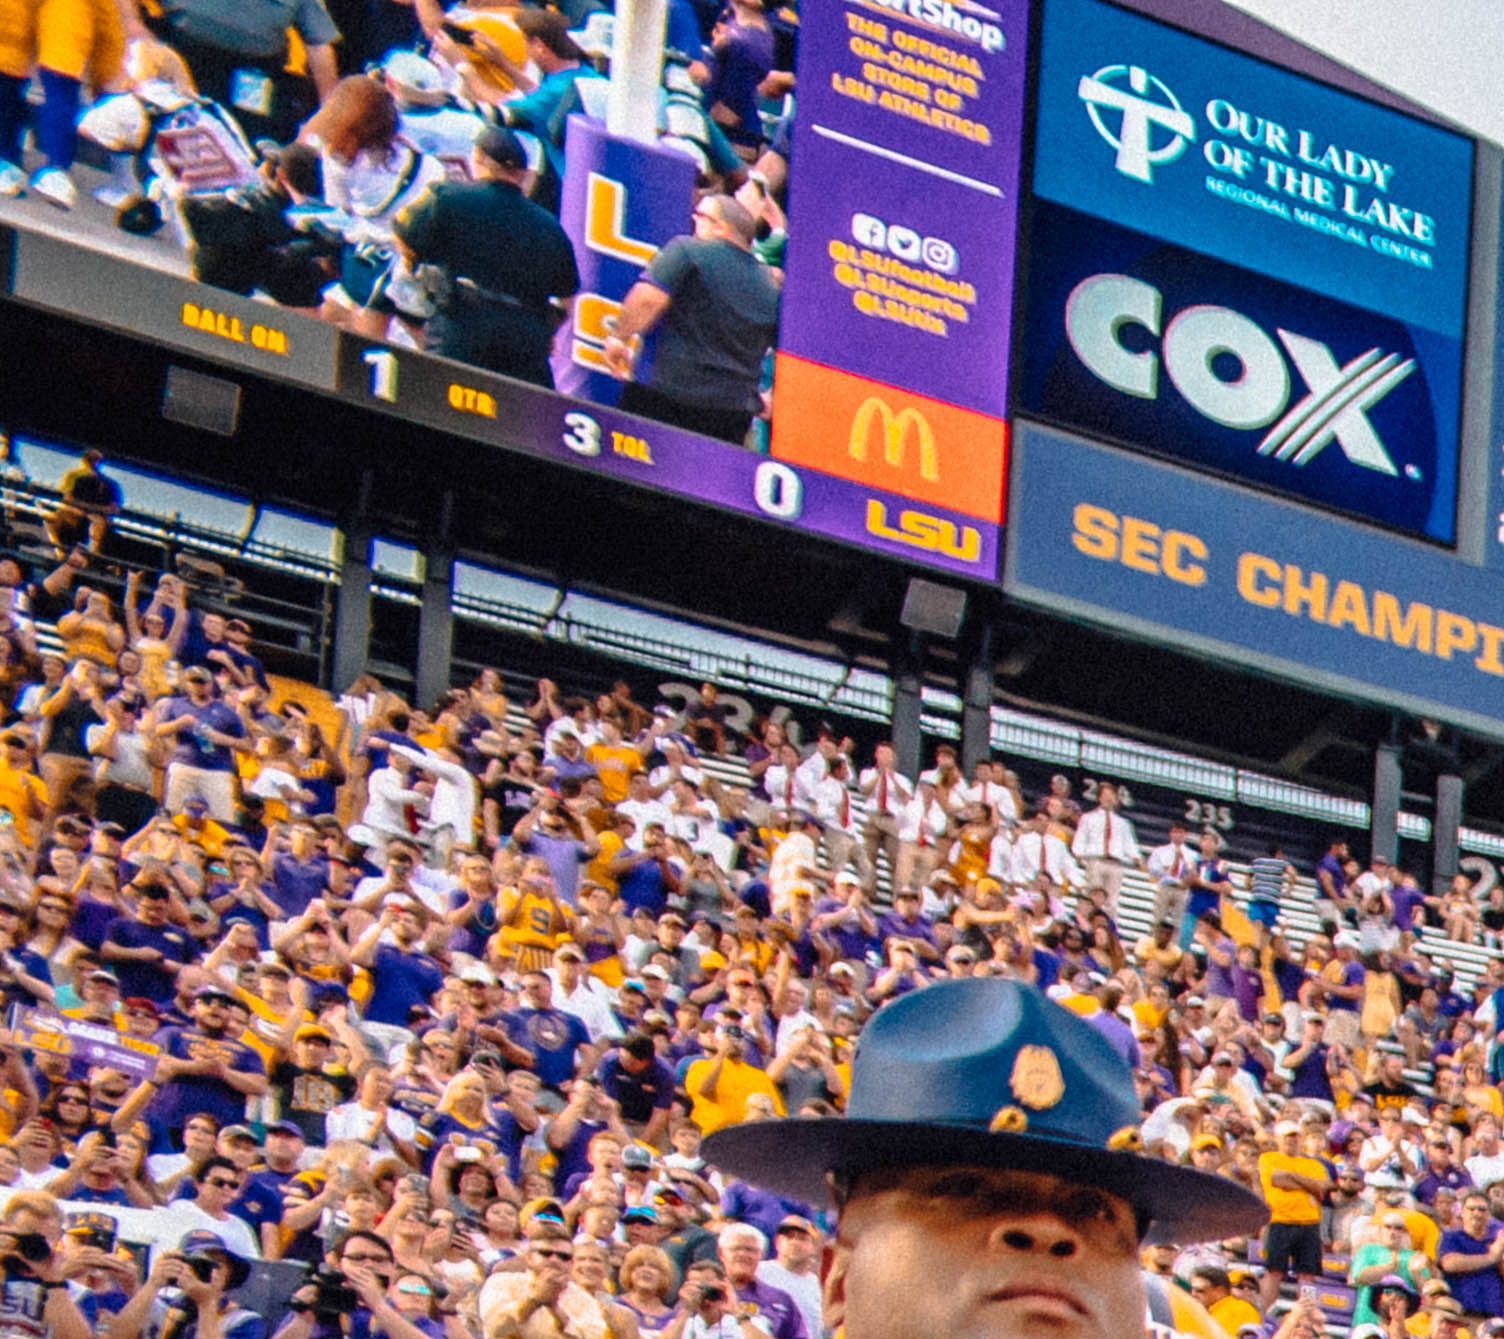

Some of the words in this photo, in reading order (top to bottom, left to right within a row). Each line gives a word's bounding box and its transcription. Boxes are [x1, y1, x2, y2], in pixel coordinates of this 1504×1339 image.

[846, 12, 888, 44] THE
[892, 31, 986, 81] OFFICIAL
[850, 37, 980, 98] ON-CAMPUS
[831, 72, 877, 105] LSU
[878, 90, 992, 146] ATHLETICS
[862, 62, 931, 101] STORE
[934, 89, 965, 113] OF
[1205, 98, 1293, 159] OUR
[1297, 128, 1397, 194] LADY
[1203, 139, 1254, 181] OF
[1259, 156, 1337, 212] THE
[1342, 184, 1436, 247] LAKE
[1205, 175, 1294, 224] REGIONAL
[1293, 207, 1369, 249] MEDICAL
[1369, 234, 1433, 271] CENTER
[1065, 272, 1420, 480] COX
[182, 303, 244, 342] BALL
[364, 349, 399, 403] 1
[448, 383, 498, 419] QTR
[563, 412, 602, 457] 3
[755, 461, 802, 520] 0
[866, 498, 981, 562] LSU
[1071, 503, 1208, 587] SEC
[1083, 778, 1136, 807] 24
[1185, 799, 1232, 830] 235
